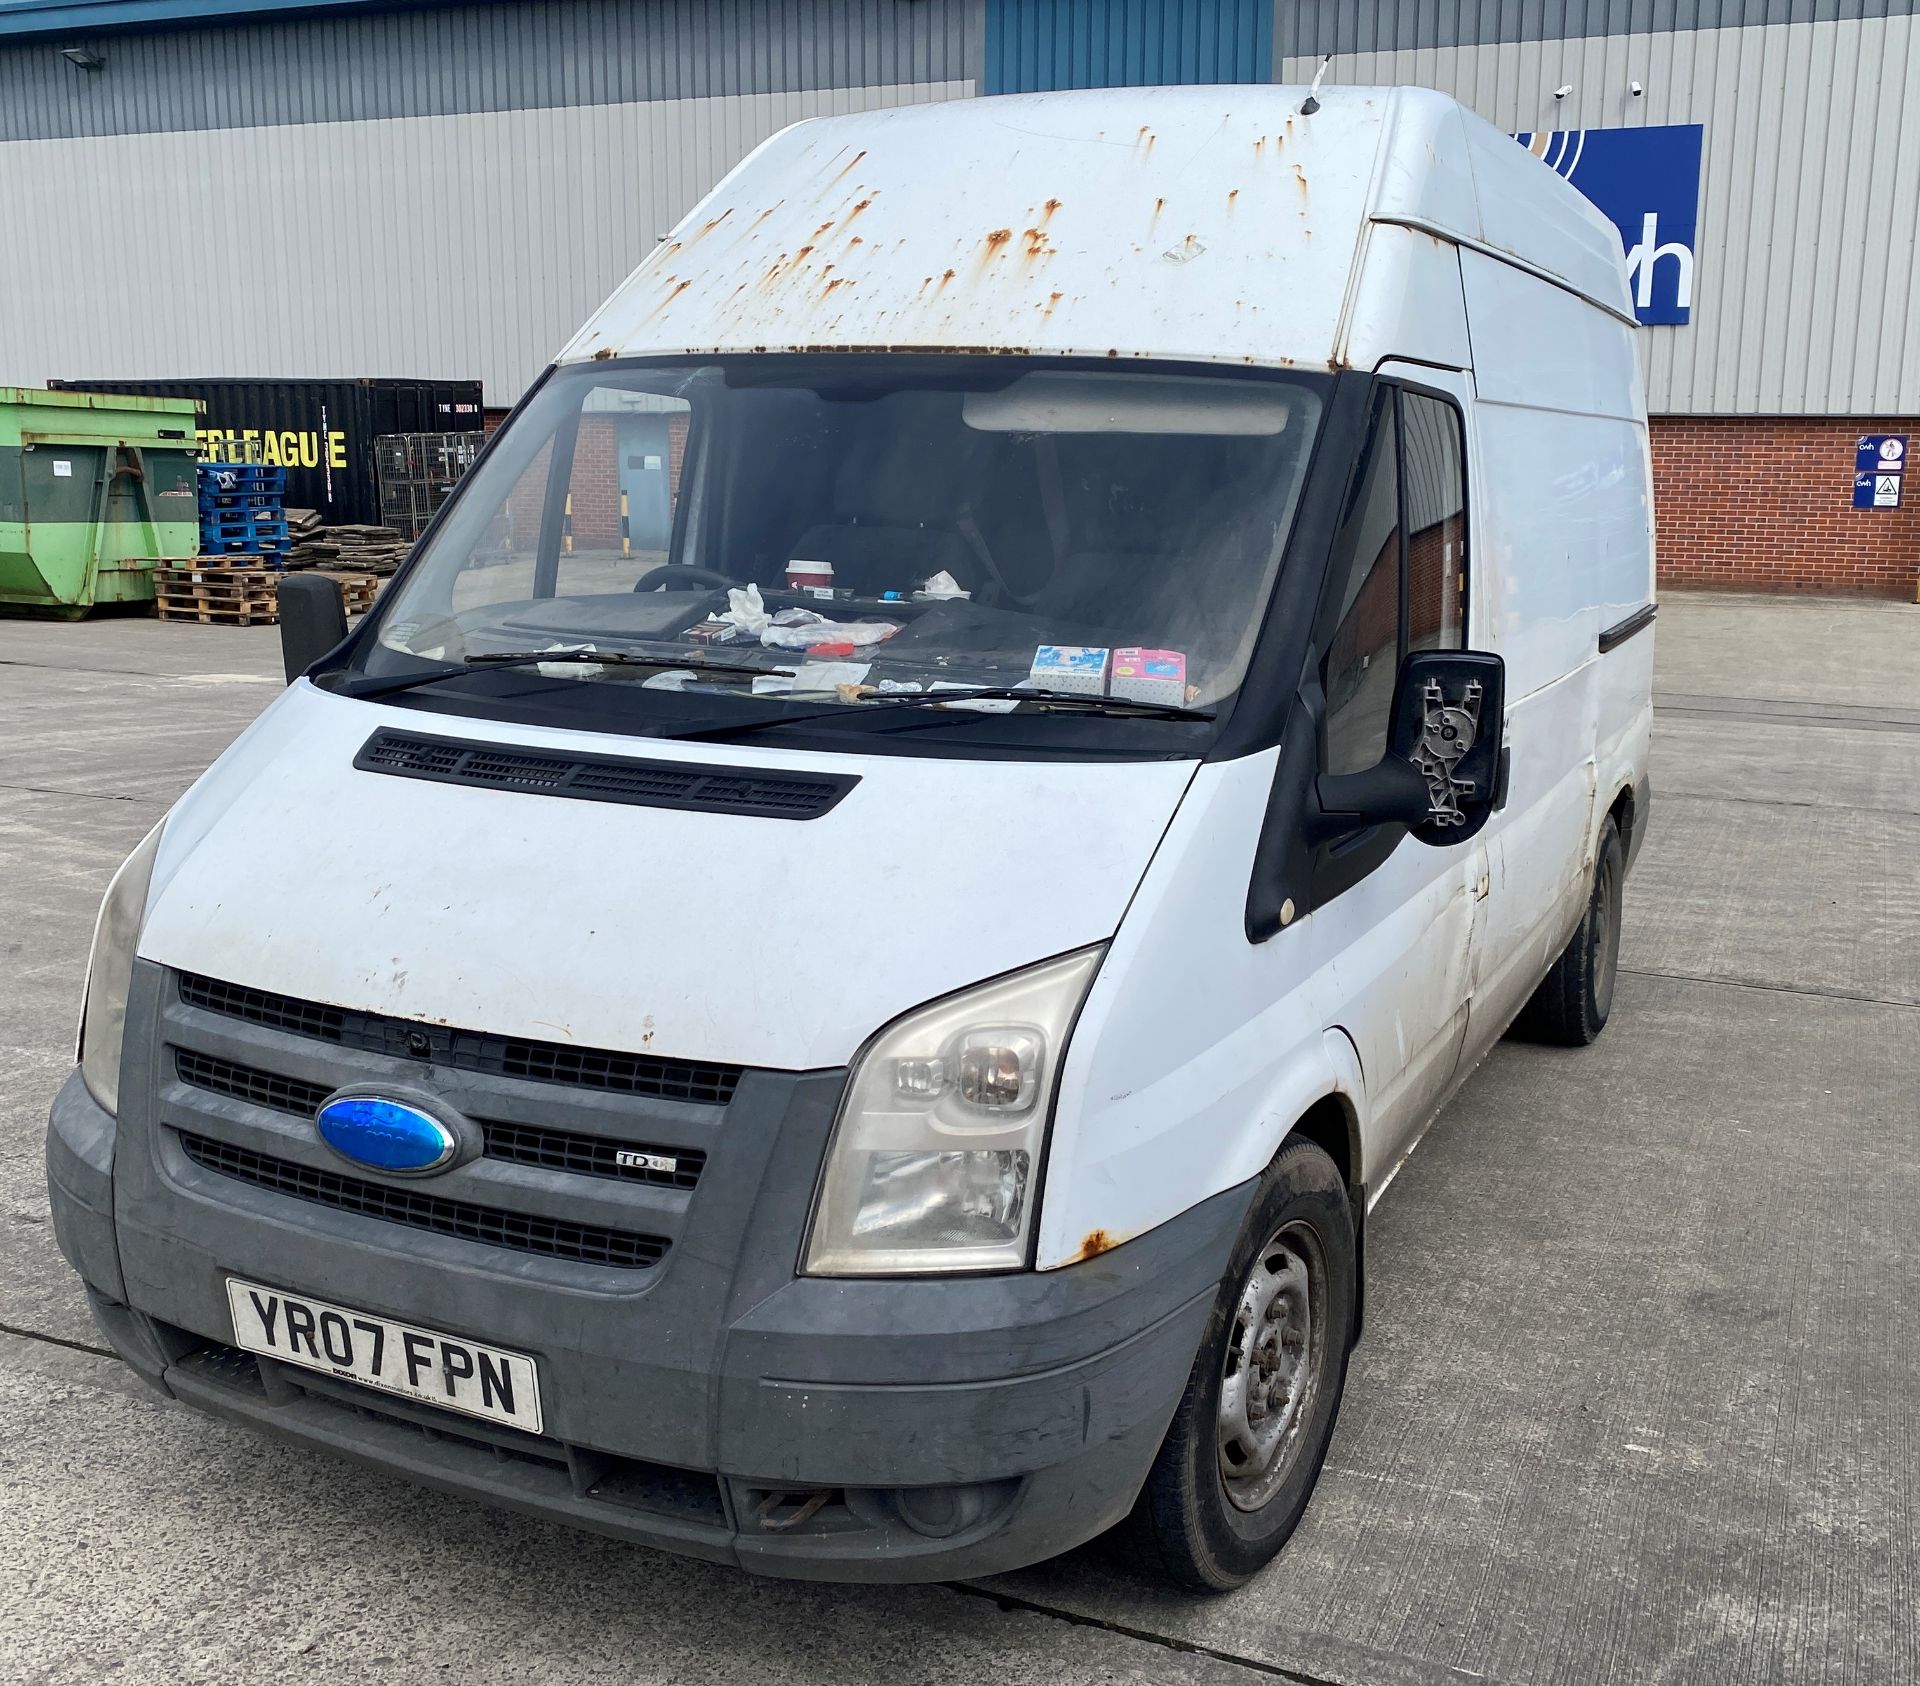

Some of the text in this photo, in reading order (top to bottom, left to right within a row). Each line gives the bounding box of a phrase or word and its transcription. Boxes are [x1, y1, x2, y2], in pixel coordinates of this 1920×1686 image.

[1626, 212, 1694, 308] h
[438, 404, 451, 413] TYNE
[250, 1291, 515, 1415] YR07 FPN
